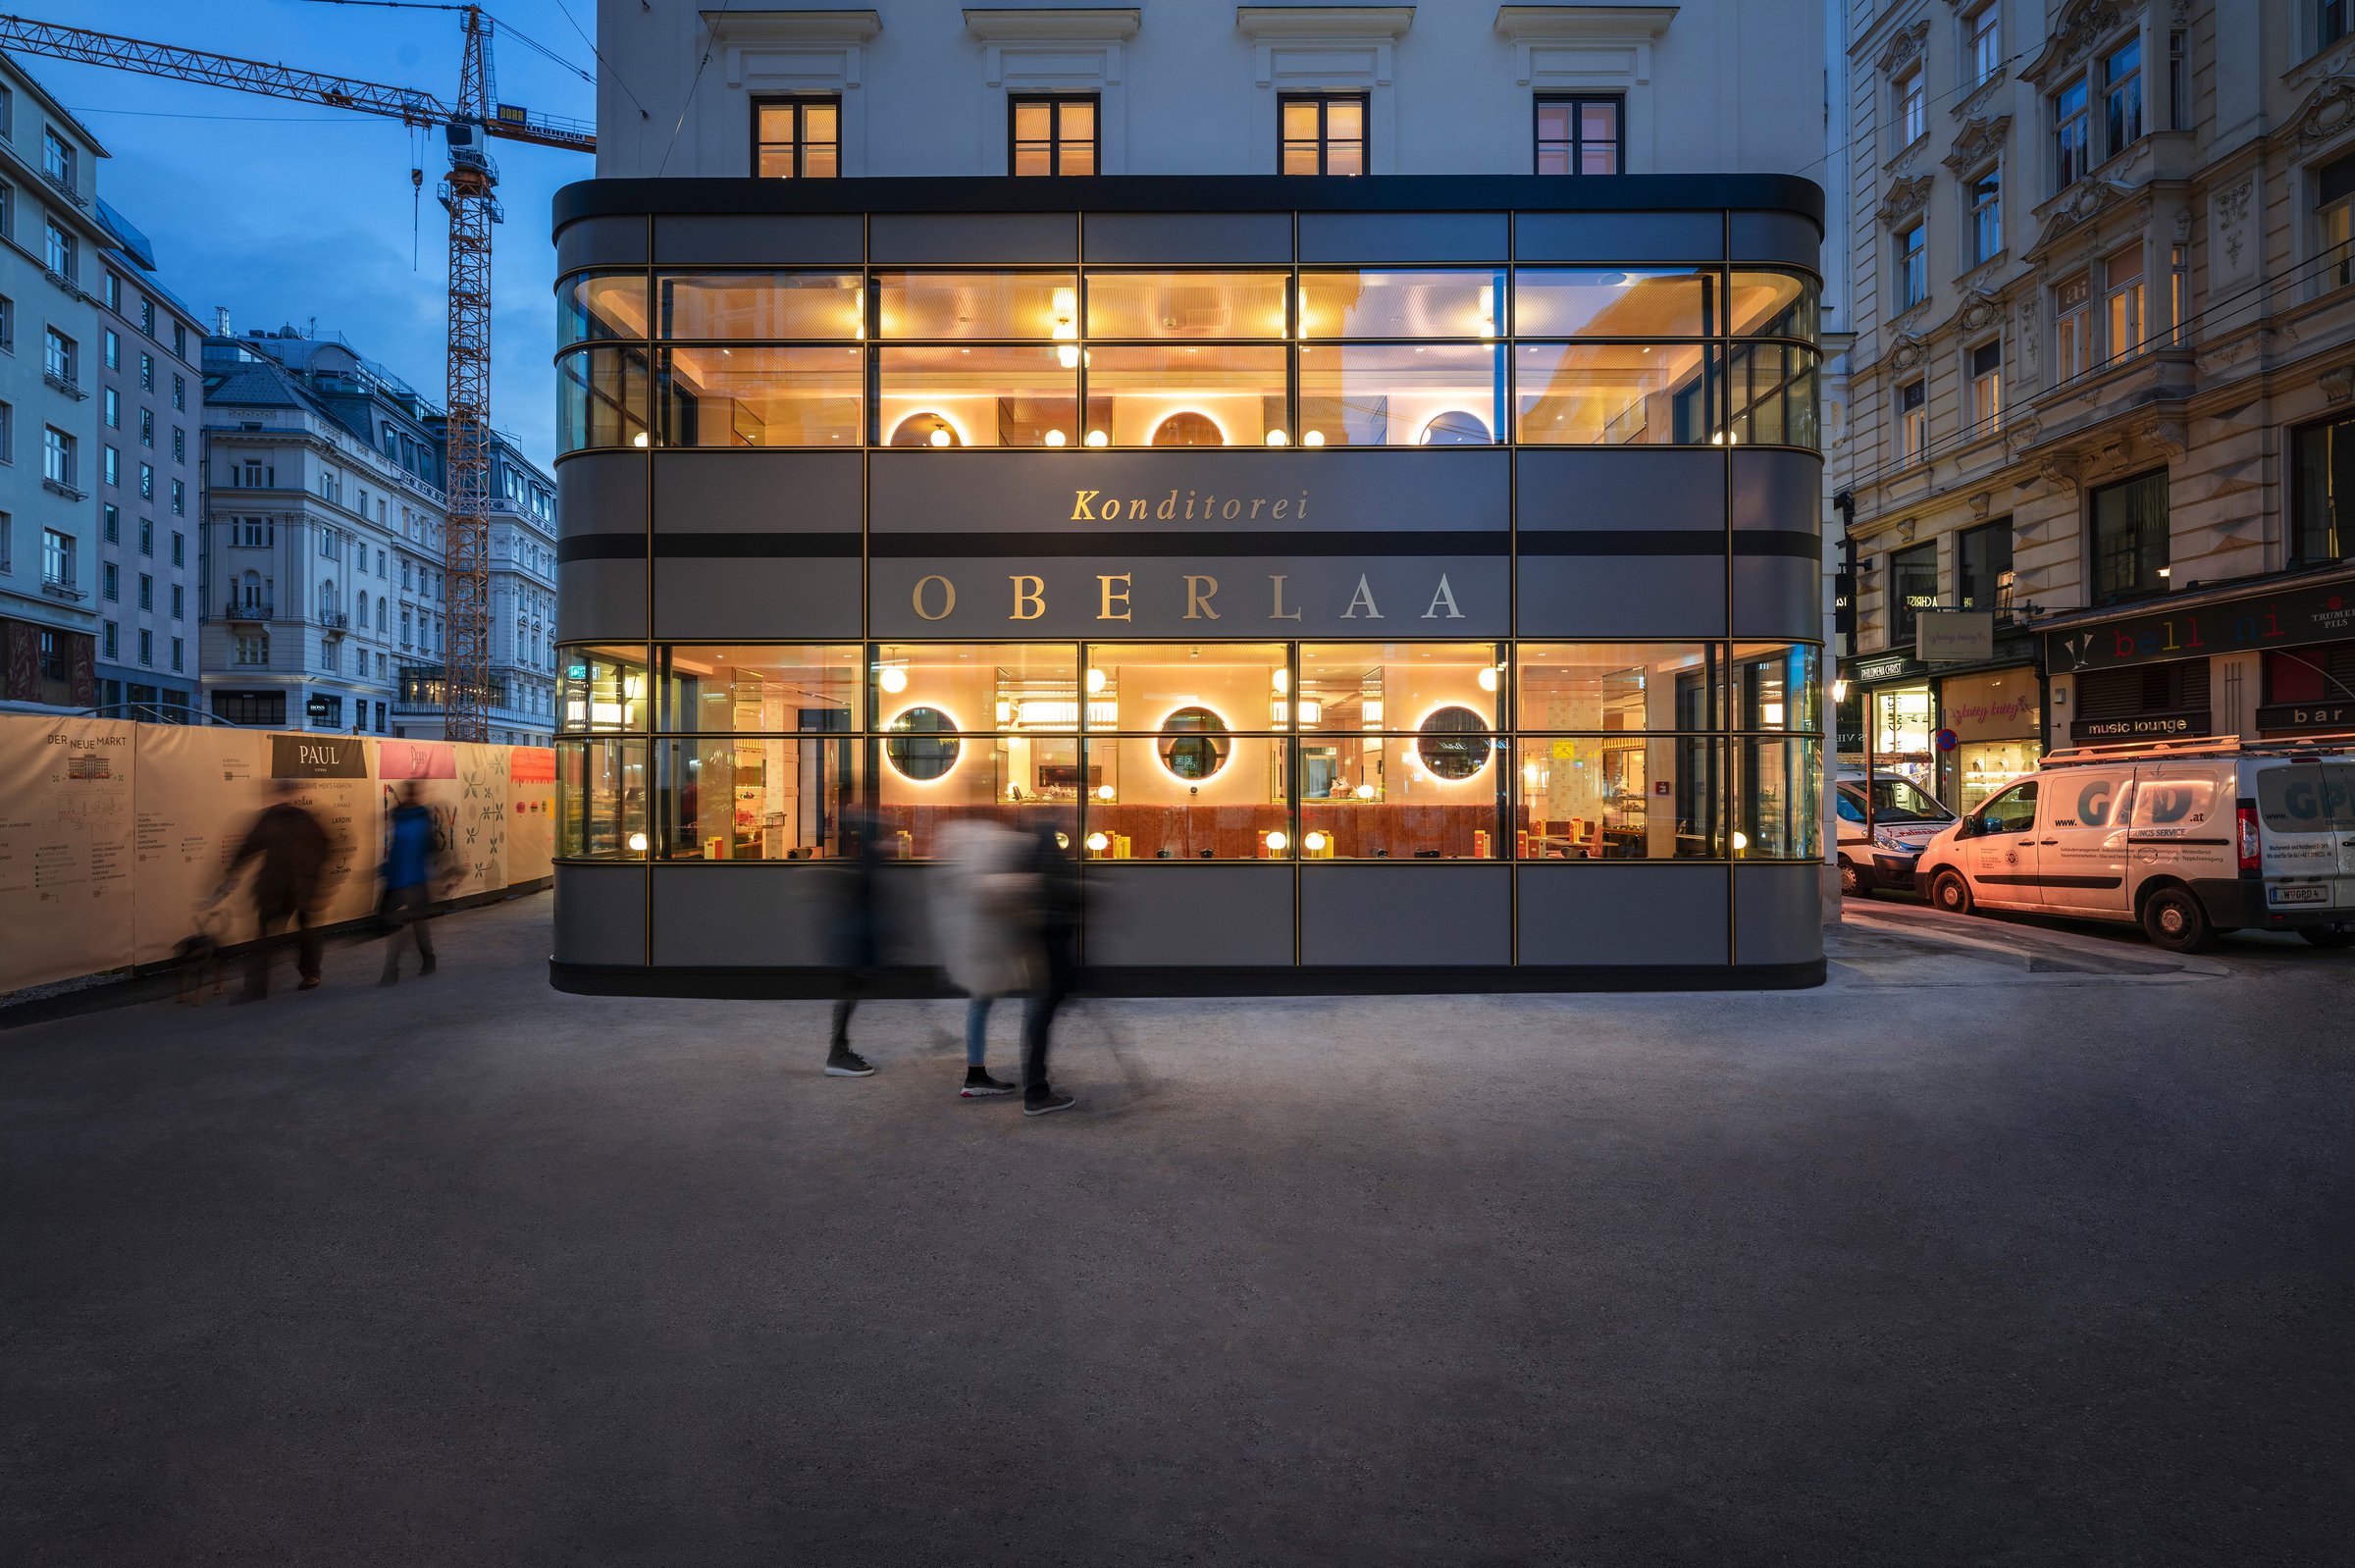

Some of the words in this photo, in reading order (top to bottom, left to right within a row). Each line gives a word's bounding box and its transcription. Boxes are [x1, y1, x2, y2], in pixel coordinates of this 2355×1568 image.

[526, 125, 585, 140] LIEBHERR
[1071, 490, 1309, 521] Konditorei
[913, 572, 1466, 622] OBERLAA
[2324, 618, 2348, 628] PILS
[1860, 665, 1886, 679] PHILOMENA
[1885, 662, 1902, 675] CHRIST
[2294, 708, 2343, 723] bar
[2088, 720, 2130, 735] music
[2134, 716, 2187, 734] lounge
[47, 734, 68, 745] DER
[70, 739, 95, 750] NEUE
[96, 736, 127, 747] MARKT
[298, 745, 340, 764] PAUL
[2156, 828, 2186, 837] SERVICE
[2283, 889, 2290, 899] W
[2296, 889, 2313, 900] GPD
[2313, 889, 2319, 898] 4
